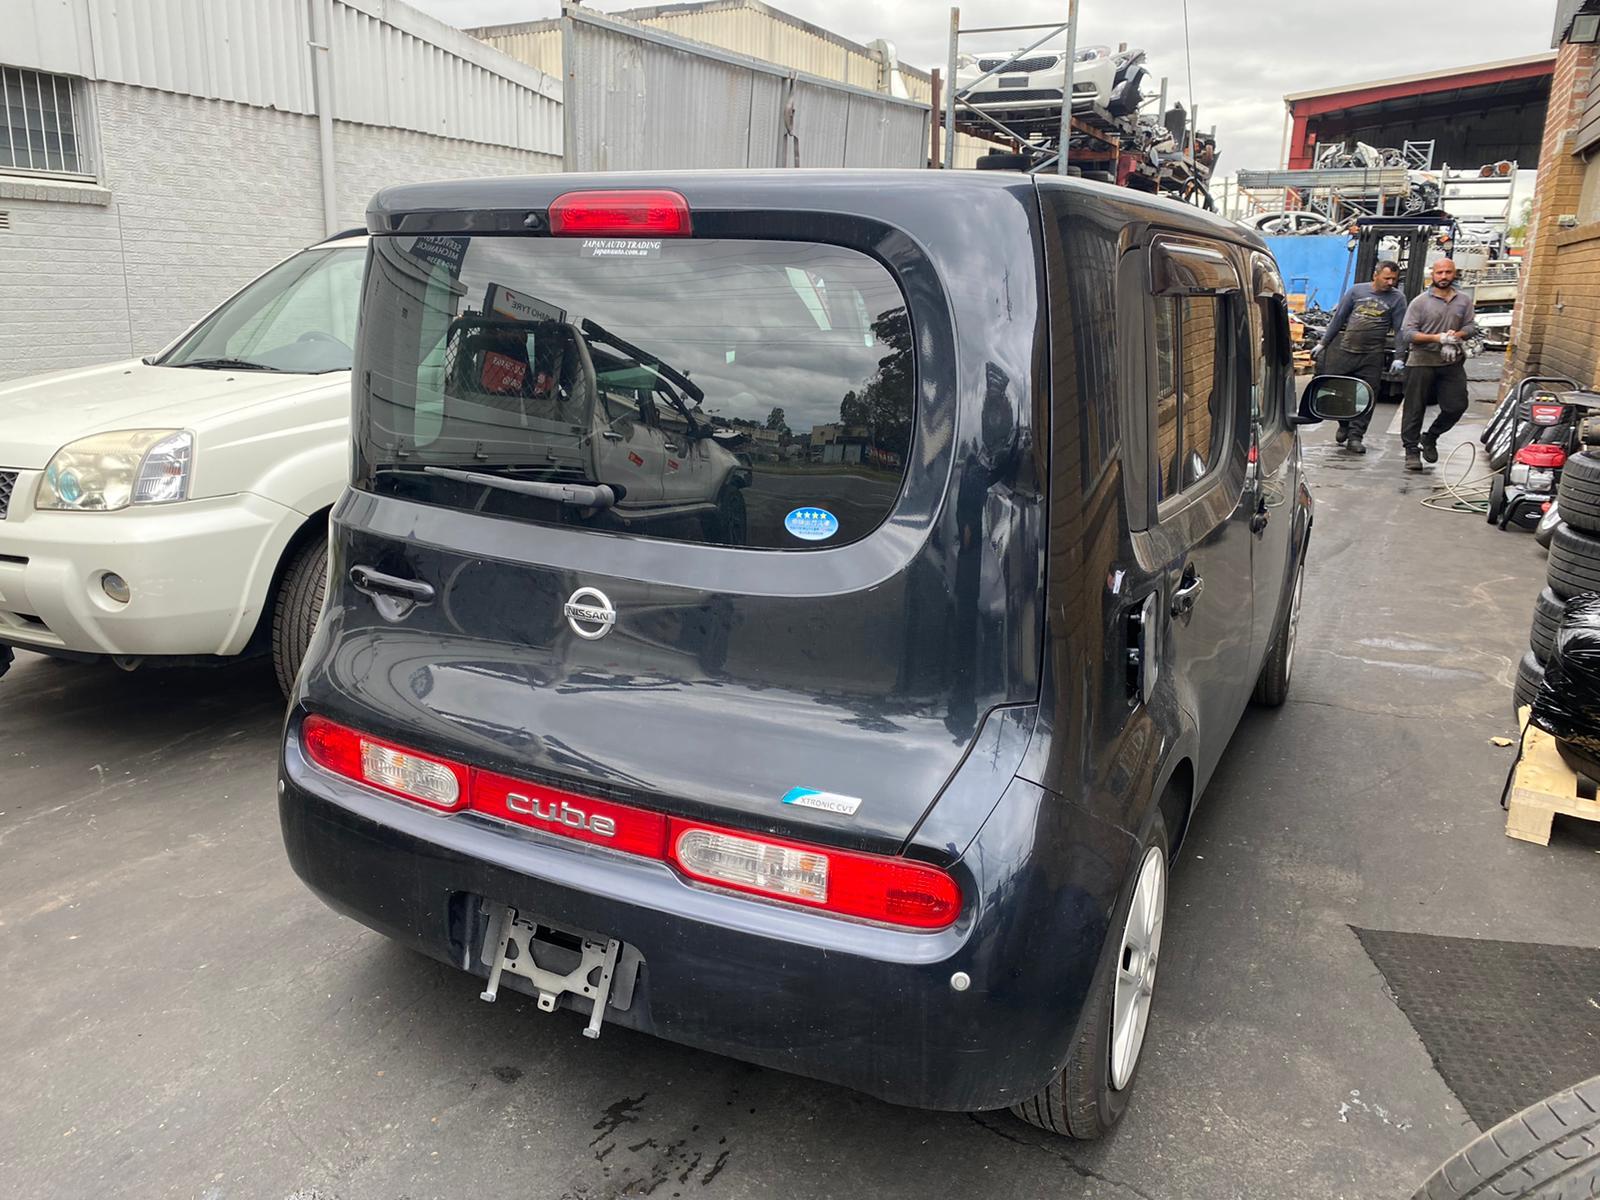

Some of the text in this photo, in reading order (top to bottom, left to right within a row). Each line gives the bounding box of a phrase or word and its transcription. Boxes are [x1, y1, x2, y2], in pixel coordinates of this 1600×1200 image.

[582, 240, 661, 249] JAPAN AUTO TRADING
[566, 605, 609, 621] NISSAN
[801, 798, 854, 812] XTRONIC CVT
[506, 793, 615, 837] cube
